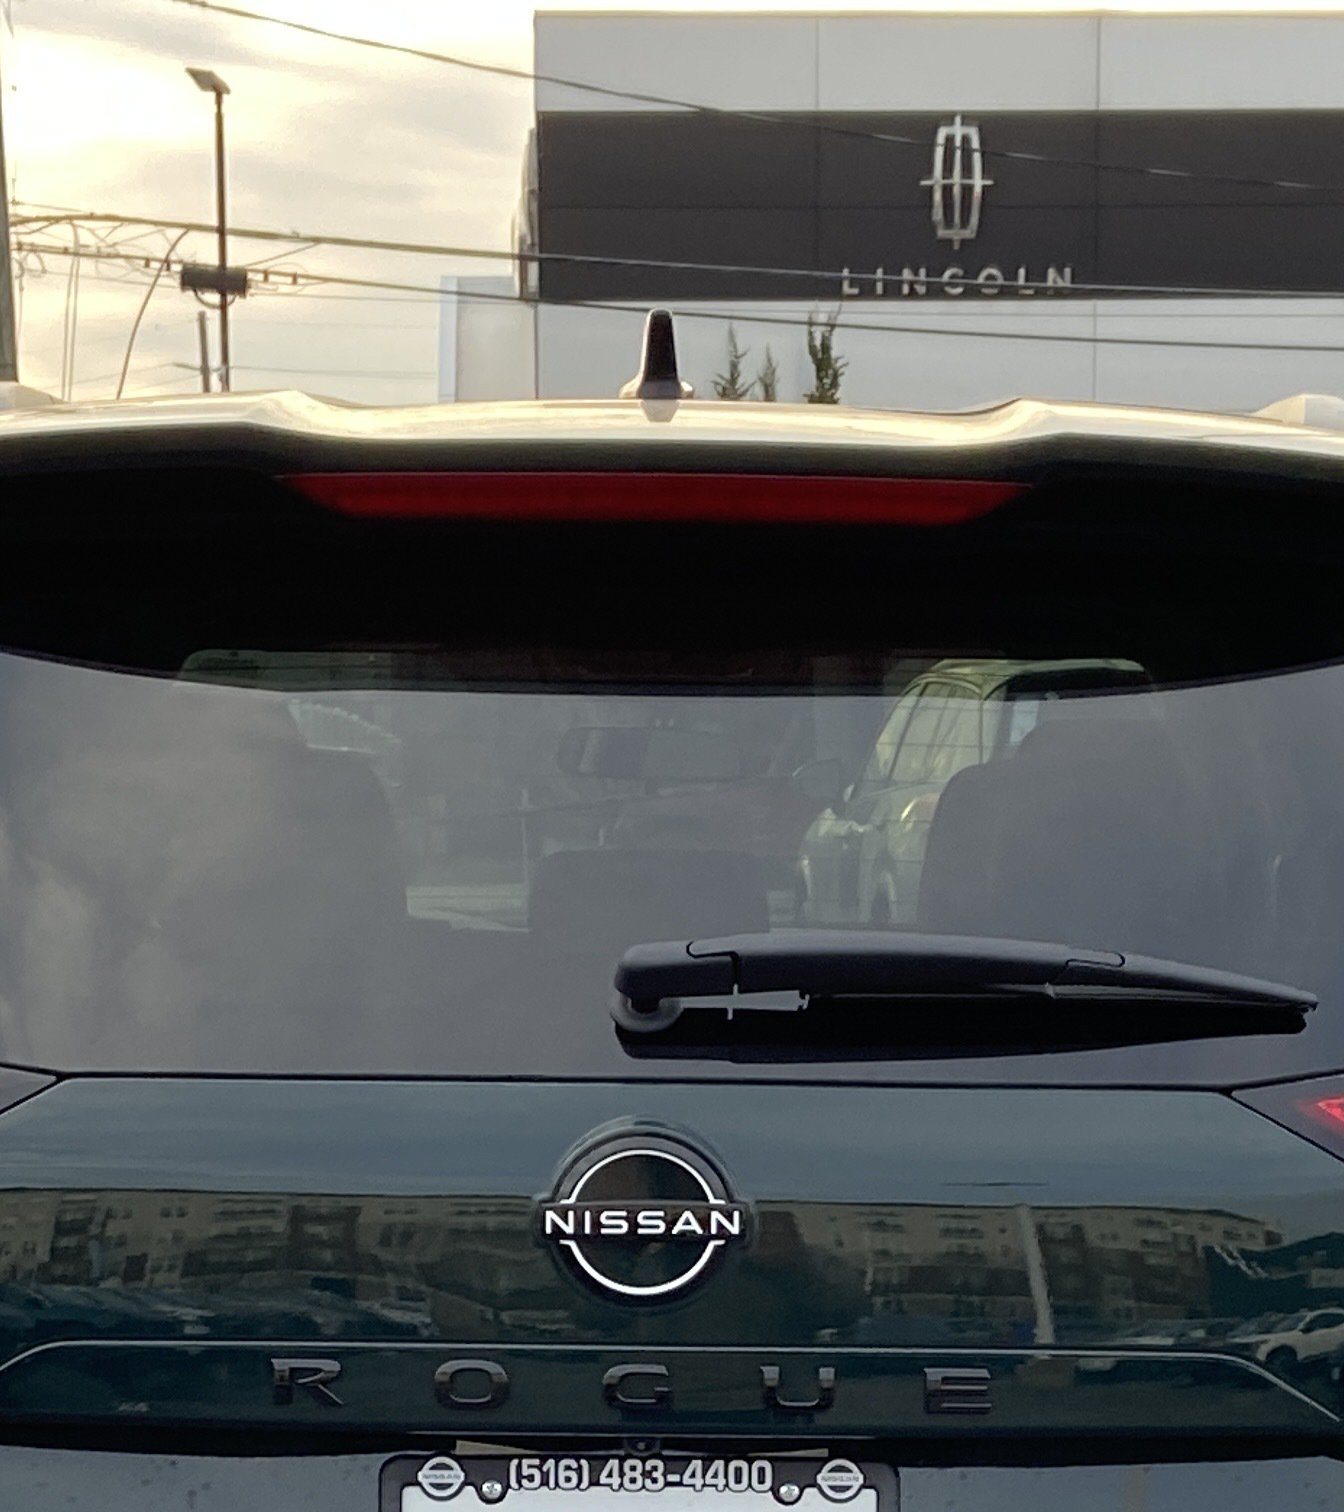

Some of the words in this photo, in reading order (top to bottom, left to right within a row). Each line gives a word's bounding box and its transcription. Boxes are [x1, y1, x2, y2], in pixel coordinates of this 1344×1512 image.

[841, 266, 1073, 296] LINCOLN
[544, 1209, 741, 1236] NISSAN
[270, 1357, 994, 1413] ROGUE
[509, 1459, 590, 1491] (516)
[599, 1460, 774, 1493] 483-4400
